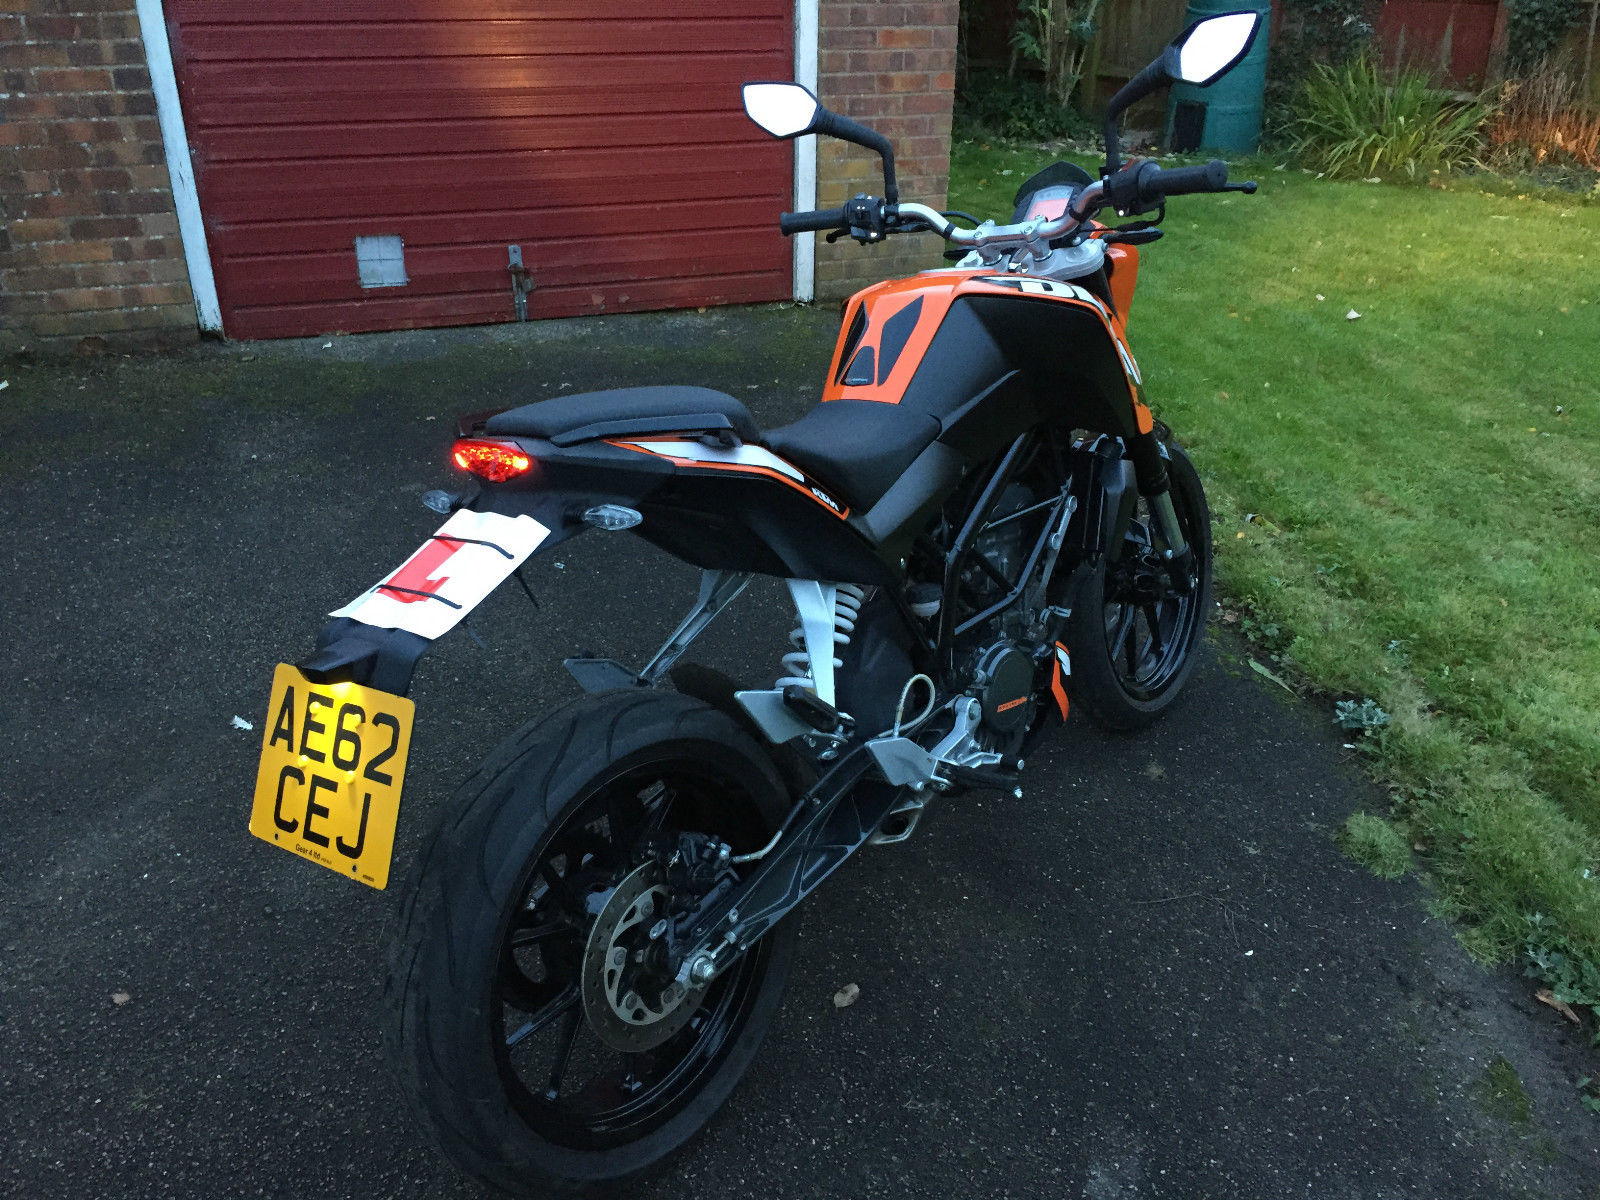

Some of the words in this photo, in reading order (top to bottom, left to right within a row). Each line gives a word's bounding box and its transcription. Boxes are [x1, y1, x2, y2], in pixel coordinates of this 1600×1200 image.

[376, 532, 467, 603] L
[269, 686, 400, 787] AE62
[273, 765, 372, 860] CEJ
